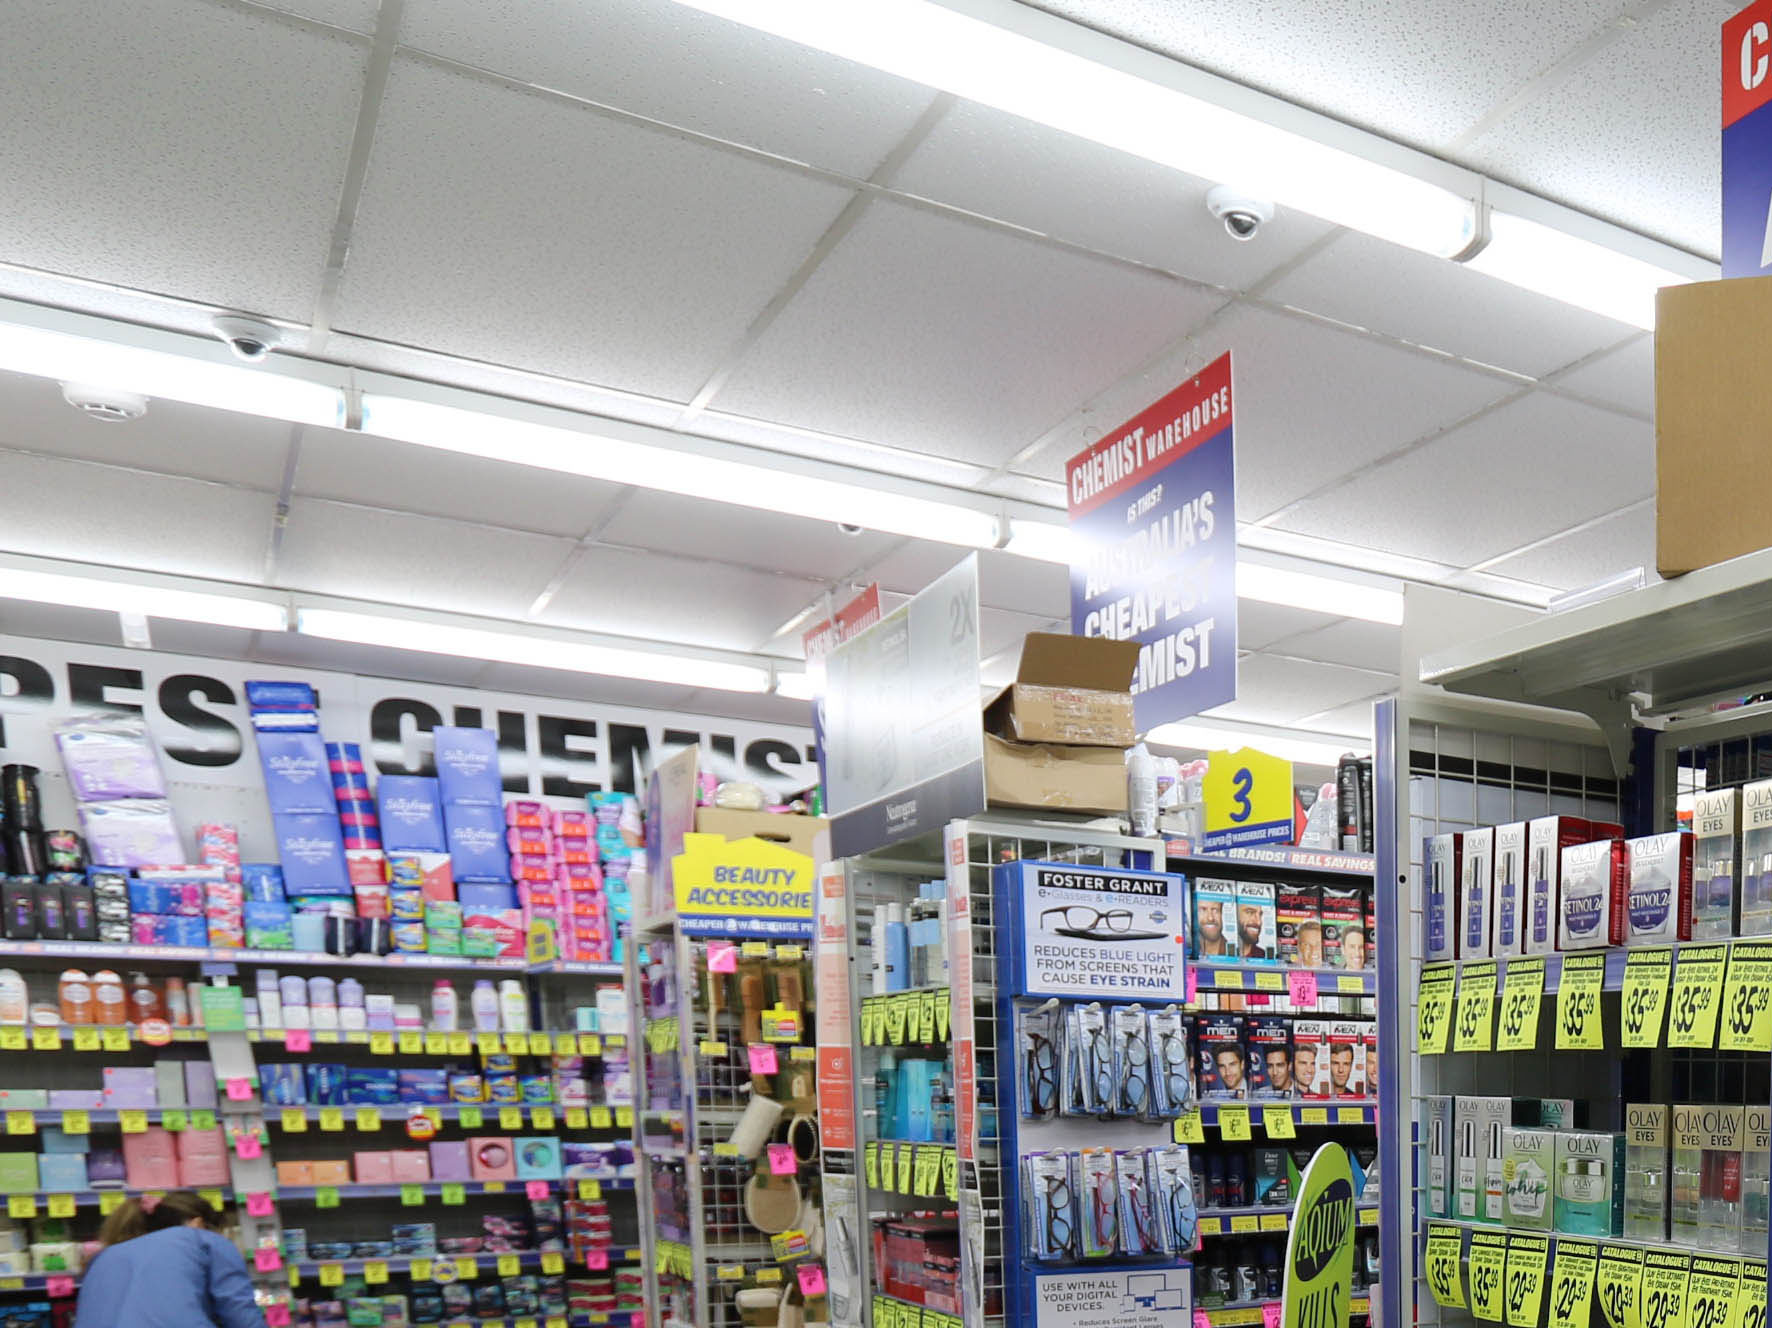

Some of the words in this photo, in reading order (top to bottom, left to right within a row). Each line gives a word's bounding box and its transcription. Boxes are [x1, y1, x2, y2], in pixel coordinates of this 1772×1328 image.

[1072, 427, 1146, 506] CHEMIST
[1146, 386, 1229, 462] WAREHOUSE
[1127, 500, 1139, 524] IS
[1139, 483, 1163, 518] THIS?
[1085, 489, 1215, 602] AUSTRALIA'S
[1228, 767, 1254, 823] 3
[1695, 796, 1731, 818] OLAY
[1702, 819, 1724, 833] EYES
[1229, 849, 1286, 864] BRANDS!
[713, 866, 796, 886] BEAUTY
[1043, 872, 1105, 889] FOSTER
[1108, 876, 1165, 894] GRANT
[687, 887, 813, 909] ACCESSORIE
[1033, 944, 1096, 959] REDUCES
[1099, 947, 1134, 961] BLUE
[1136, 950, 1174, 963] LIGHT
[1036, 958, 1076, 972] FROM
[1079, 960, 1138, 975] SCREENS
[1142, 964, 1174, 977] THAT
[1041, 972, 1088, 985] CAUSE
[1089, 973, 1117, 986] EYE
[1120, 974, 1170, 988] STRAIN
[1628, 1110, 1662, 1127] OLAY
[1634, 1130, 1656, 1142] EYES
[1566, 1139, 1600, 1155] OLAY
[1042, 1282, 1064, 1293] USE
[1066, 1280, 1095, 1292] WITH
[1098, 1279, 1118, 1289] ALL
[1043, 1291, 1074, 1303] YOUR
[1076, 1289, 1118, 1302] DIGITAL
[1056, 1301, 1105, 1312] DEVICES.
[1078, 1318, 1109, 1327] Reduces
[1111, 1316, 1136, 1325] Screen
[1137, 1315, 1158, 1324] Glare
